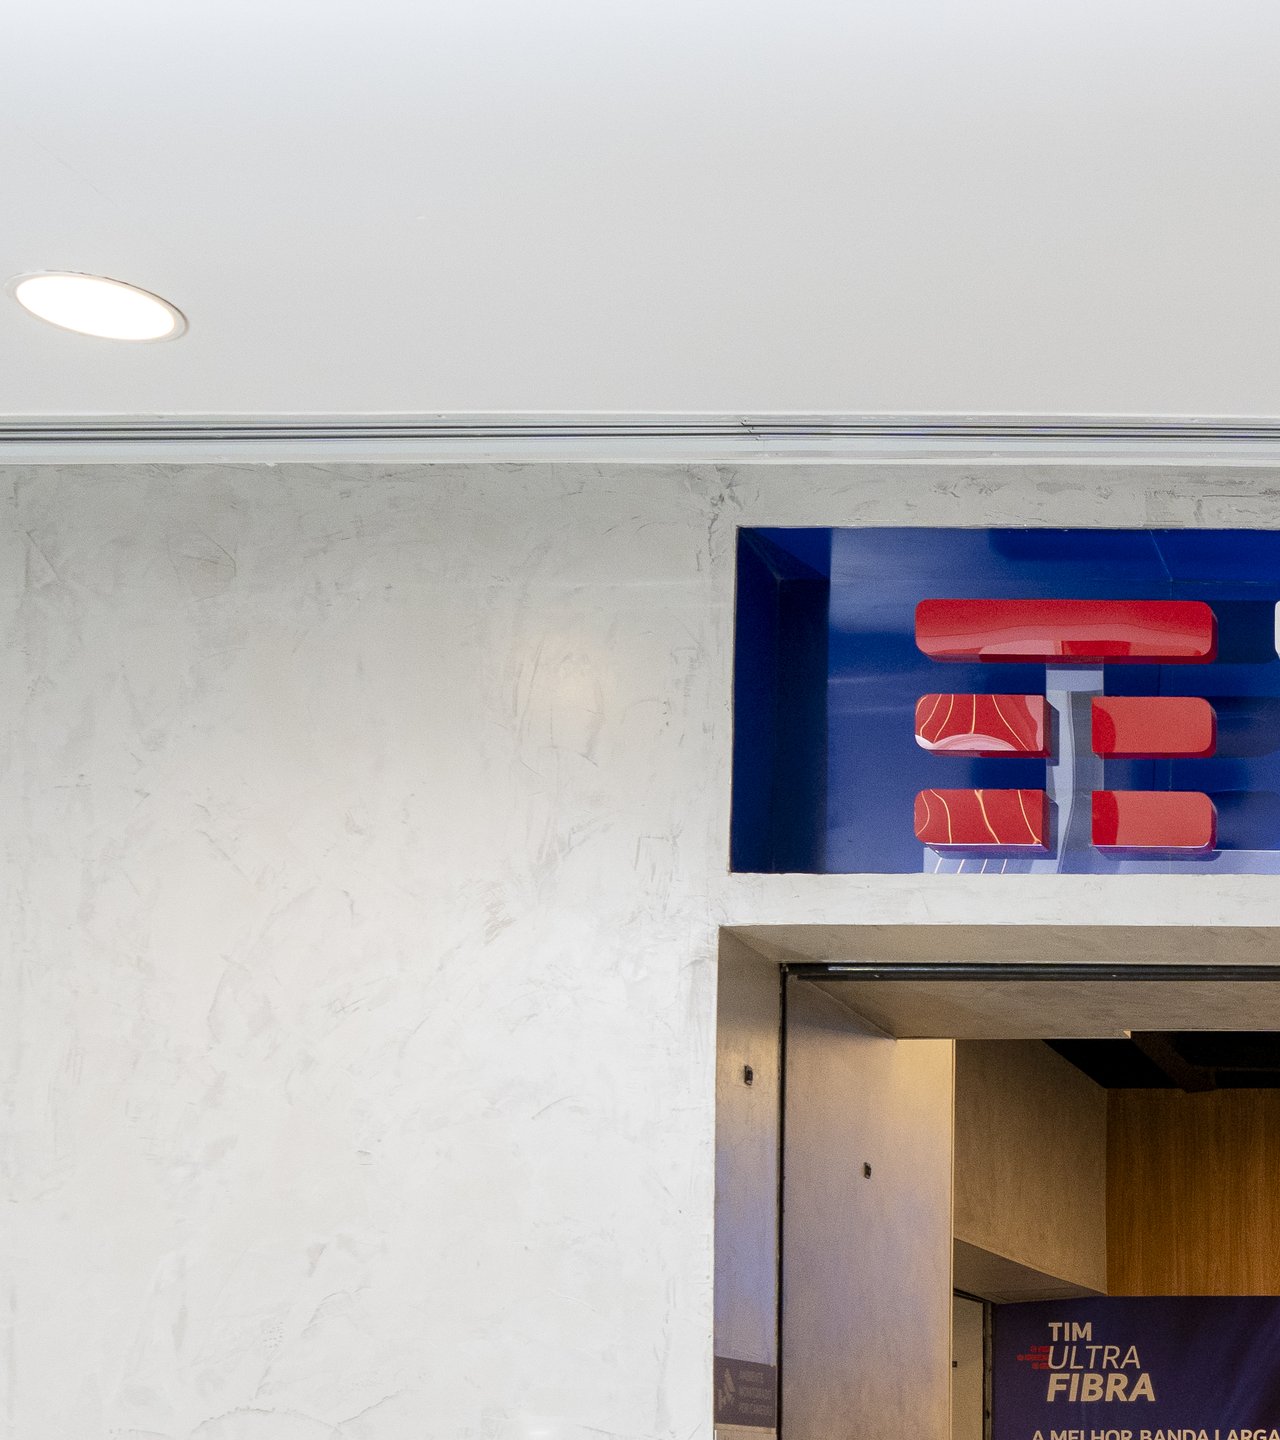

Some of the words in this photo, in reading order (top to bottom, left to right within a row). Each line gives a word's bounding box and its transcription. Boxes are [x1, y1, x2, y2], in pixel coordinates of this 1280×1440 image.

[1048, 1322, 1092, 1342] TIM
[1047, 1346, 1140, 1370] ULTRA
[1046, 1373, 1156, 1402] FIBRA
